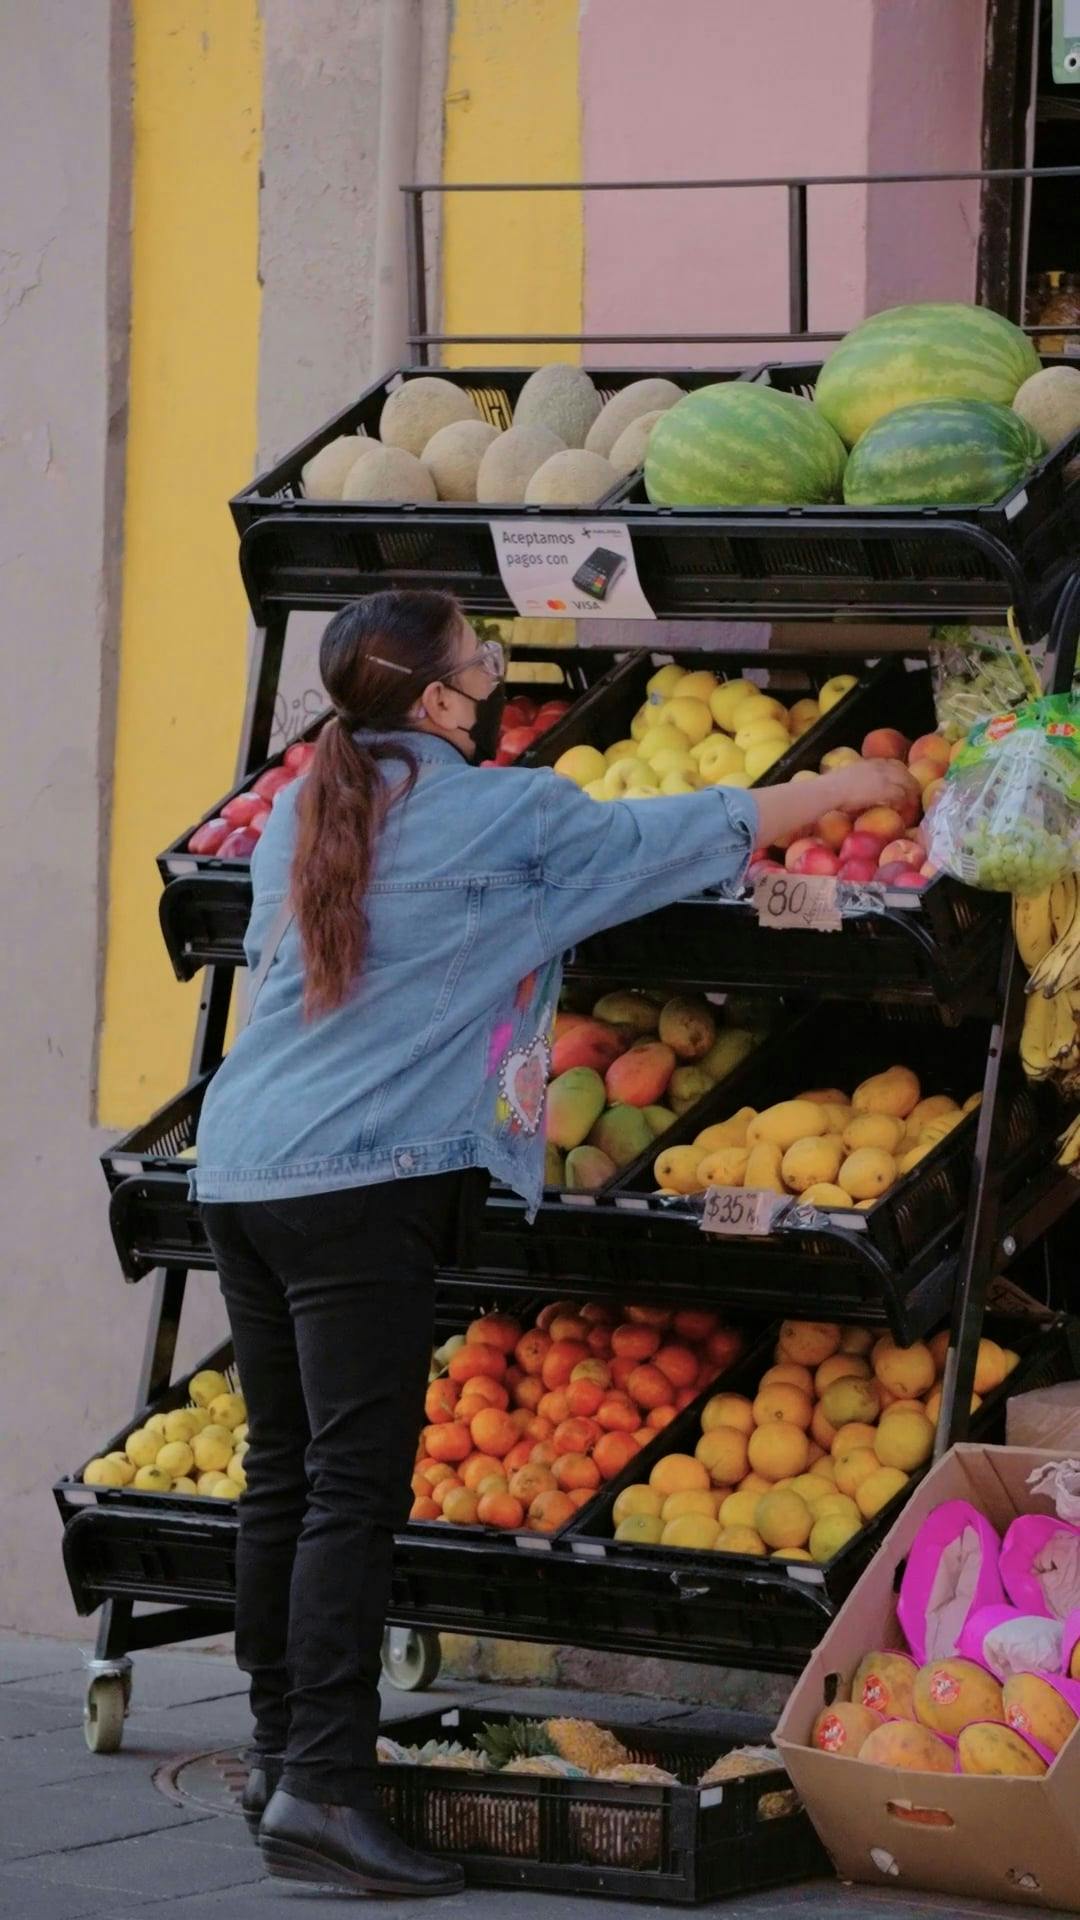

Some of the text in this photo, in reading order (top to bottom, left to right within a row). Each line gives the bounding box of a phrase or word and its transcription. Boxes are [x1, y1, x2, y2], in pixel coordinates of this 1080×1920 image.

[502, 530, 576, 547] Aceptamos
[506, 552, 568, 568] pagos con
[571, 600, 601, 610] VISA
